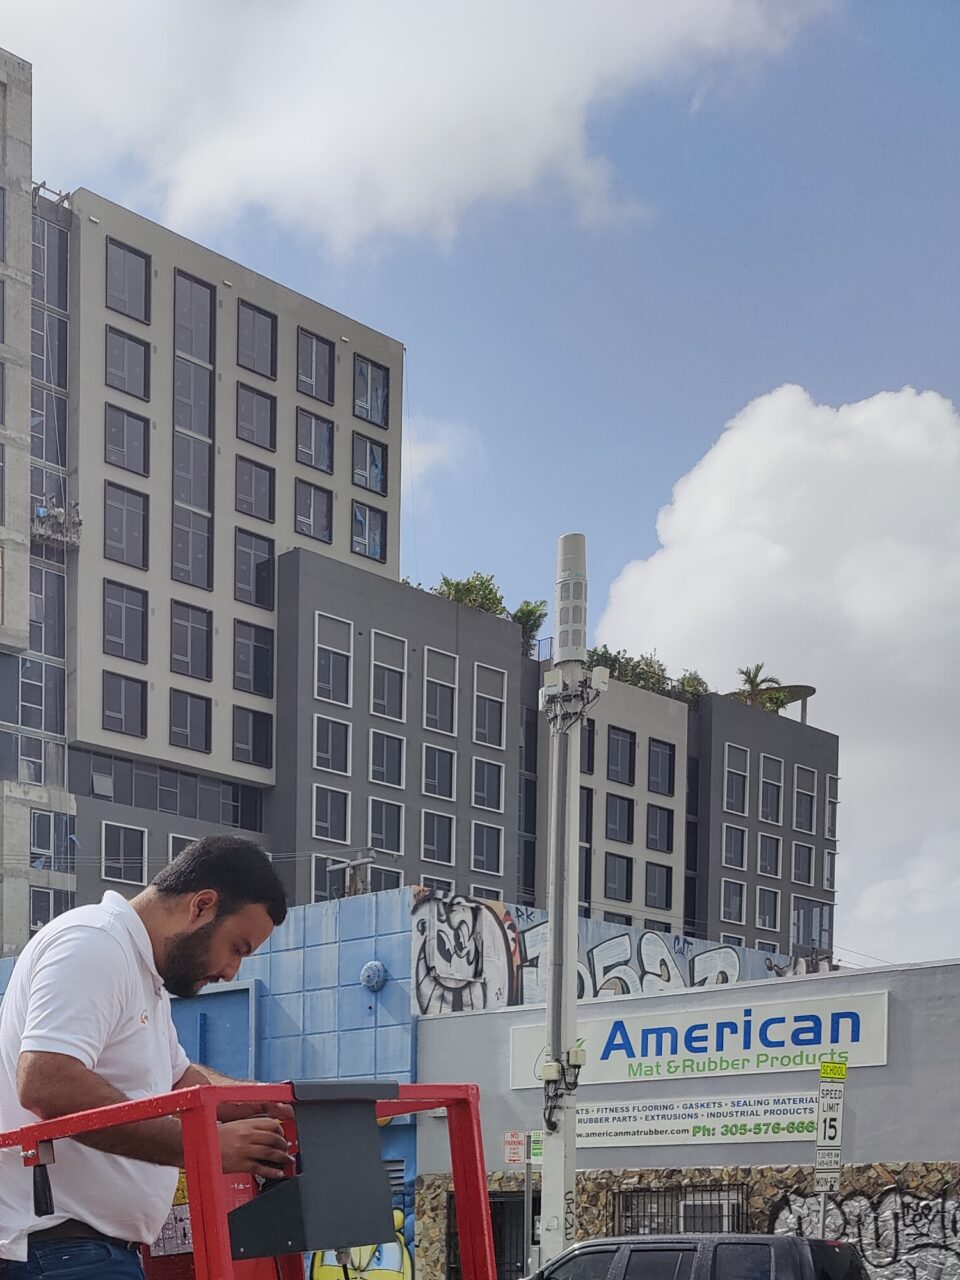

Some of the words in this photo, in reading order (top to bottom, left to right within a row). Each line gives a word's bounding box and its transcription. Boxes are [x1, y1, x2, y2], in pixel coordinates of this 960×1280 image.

[600, 1009, 860, 1060] American
[627, 1063, 662, 1078] Mat
[755, 1049, 849, 1069] Products
[822, 1064, 845, 1077] SCHOOL
[821, 1089, 843, 1100] SPEED
[576, 1108, 590, 1116] ATS
[596, 1106, 630, 1114] FITNESS
[632, 1104, 675, 1112] FLOORING
[681, 1101, 723, 1110] GASKETS
[730, 1099, 770, 1107] SEALING
[772, 1097, 819, 1105] MATERIAL
[822, 1102, 840, 1113] LIMIT
[577, 1116, 610, 1124] RUBBER
[612, 1115, 638, 1123] PARTS
[644, 1112, 699, 1121] EXTRUSIONS
[706, 1109, 761, 1118] INDUSTRIAL
[763, 1107, 814, 1116] PRODUCTS
[576, 1128, 689, 1137] w.americanmatrubber.com
[692, 1124, 716, 1137] Ph:
[720, 1120, 817, 1137] 305-576-666
[823, 1117, 837, 1141] 15
